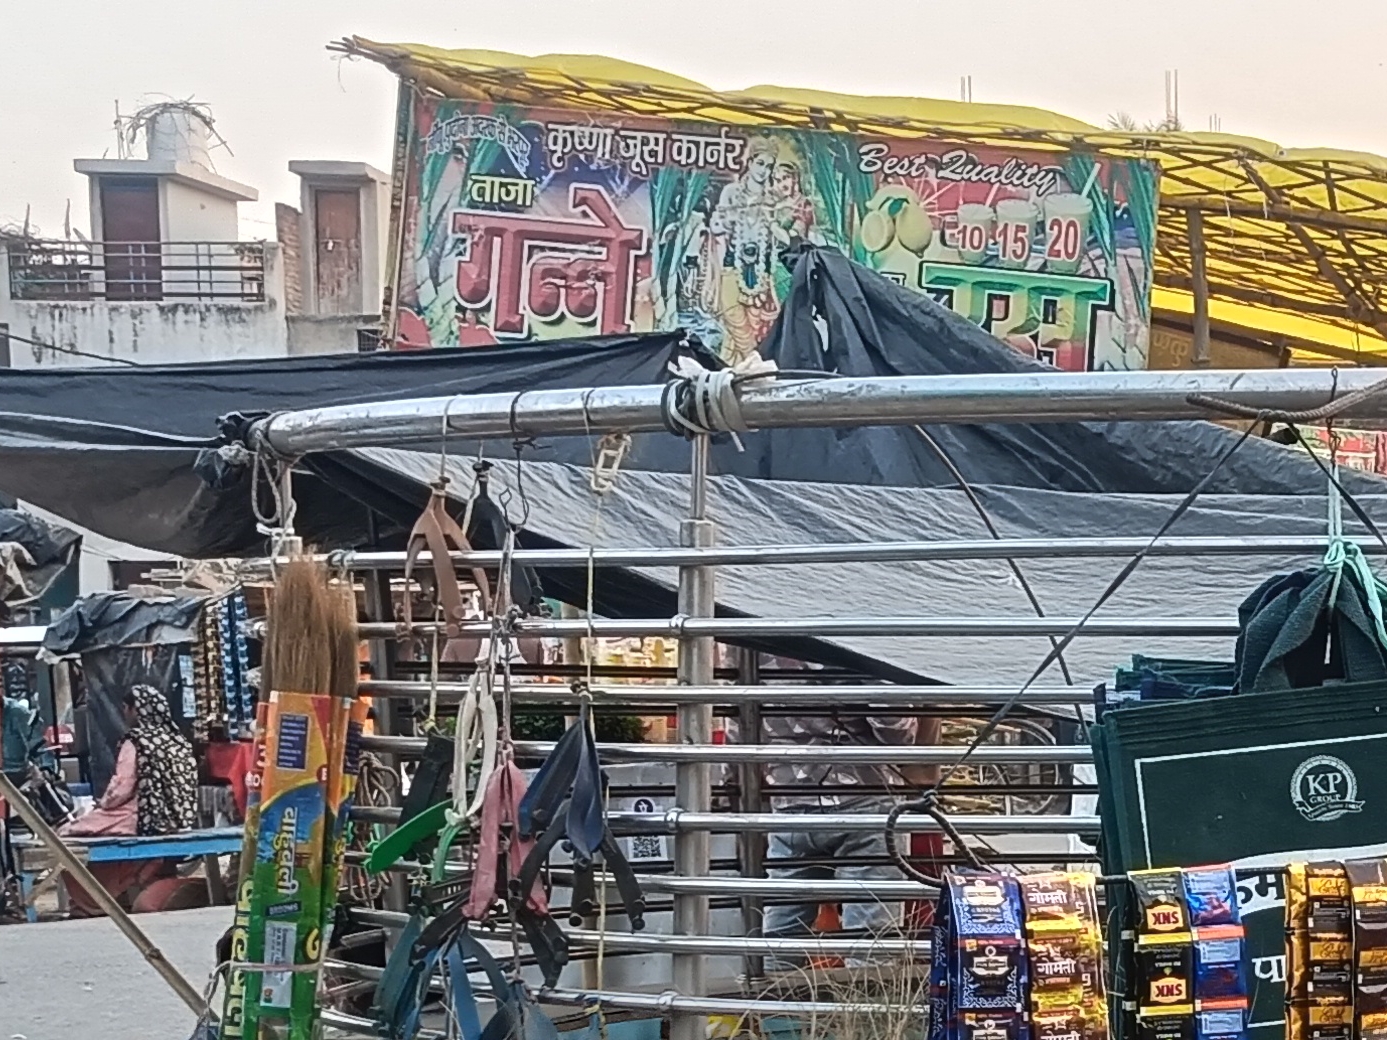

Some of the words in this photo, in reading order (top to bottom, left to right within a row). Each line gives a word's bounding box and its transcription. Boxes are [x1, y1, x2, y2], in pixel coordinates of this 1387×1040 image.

[547, 122, 615, 170] कृष्णा
[618, 130, 667, 176] जूस
[671, 126, 745, 171] कार्नर
[858, 143, 927, 174] Best
[938, 149, 1056, 196] Quality
[470, 175, 536, 207] ताजा
[956, 224, 985, 251] 10
[998, 221, 1027, 261] 15
[1048, 217, 1079, 262] 20
[1306, 772, 1342, 796] KP
[1309, 793, 1341, 804] GROUP
[1028, 889, 1067, 904] गोमती
[1152, 911, 1180, 925] SNK
[1037, 958, 1076, 976] गोमती
[1155, 983, 1183, 997] SNK
